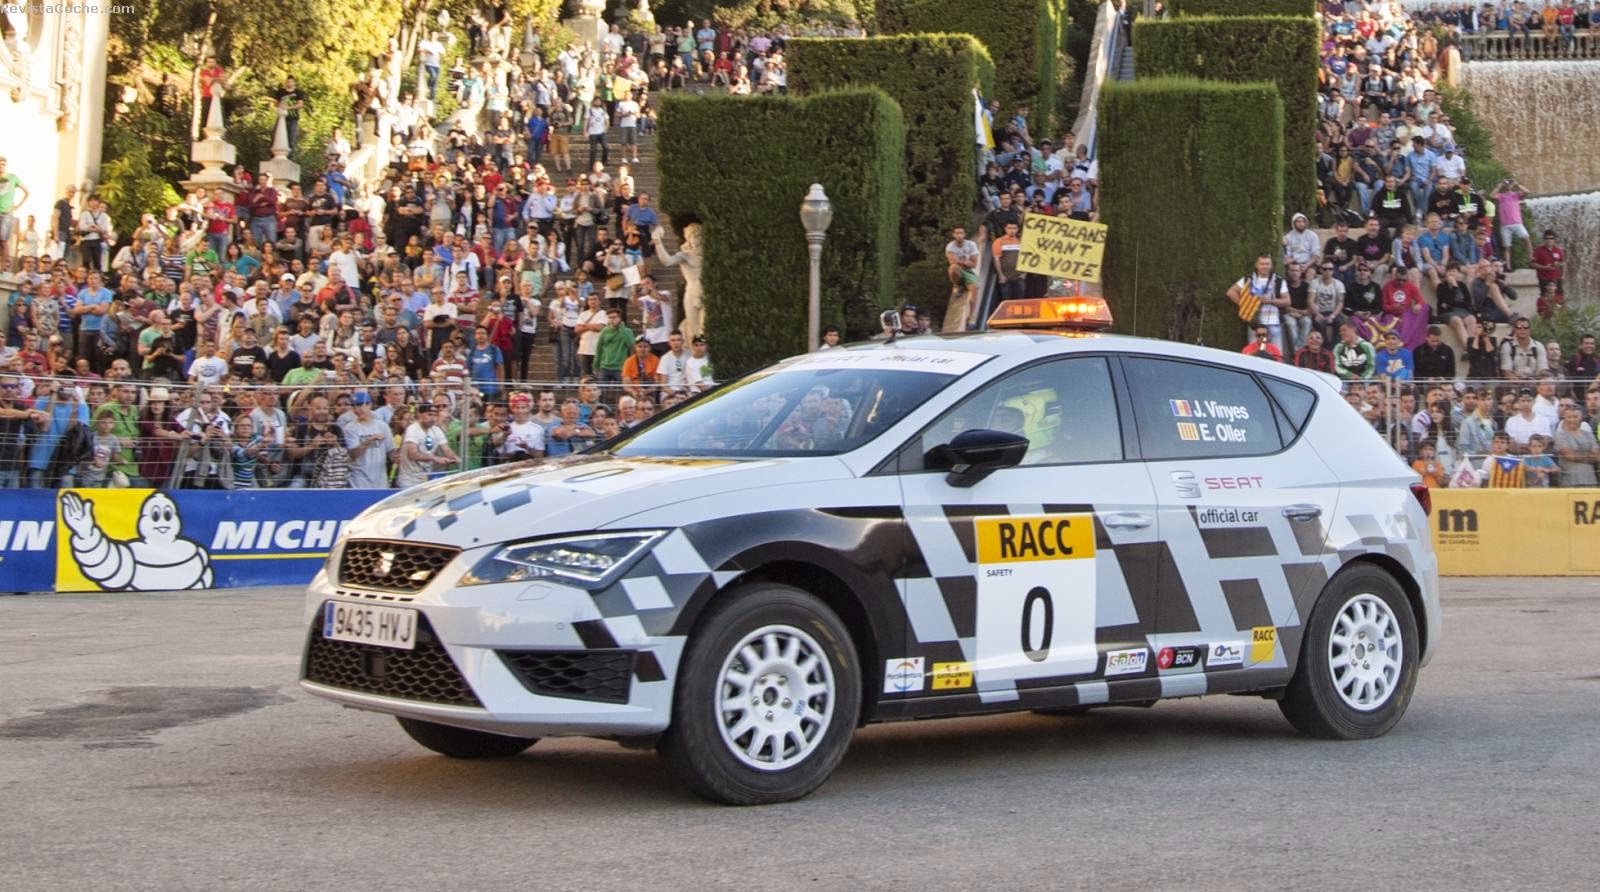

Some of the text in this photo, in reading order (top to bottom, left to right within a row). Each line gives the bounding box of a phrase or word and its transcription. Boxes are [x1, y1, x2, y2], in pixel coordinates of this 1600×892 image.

[1024, 217, 1107, 243] CATALANS
[1036, 236, 1092, 256] WANT
[1020, 251, 1099, 278] TO VOTE
[1193, 400, 1249, 422] J. Vinyes
[1199, 423, 1247, 443] E. Oller
[1204, 476, 1263, 490] SEAT
[1200, 509, 1259, 523] official car
[998, 519, 1074, 558] RACC
[986, 568, 1013, 578] SAFETY
[335, 607, 413, 643] 9435 HVJ
[1021, 585, 1054, 663] 0
[1253, 629, 1275, 641] RACC
[1175, 654, 1194, 665] BCN
